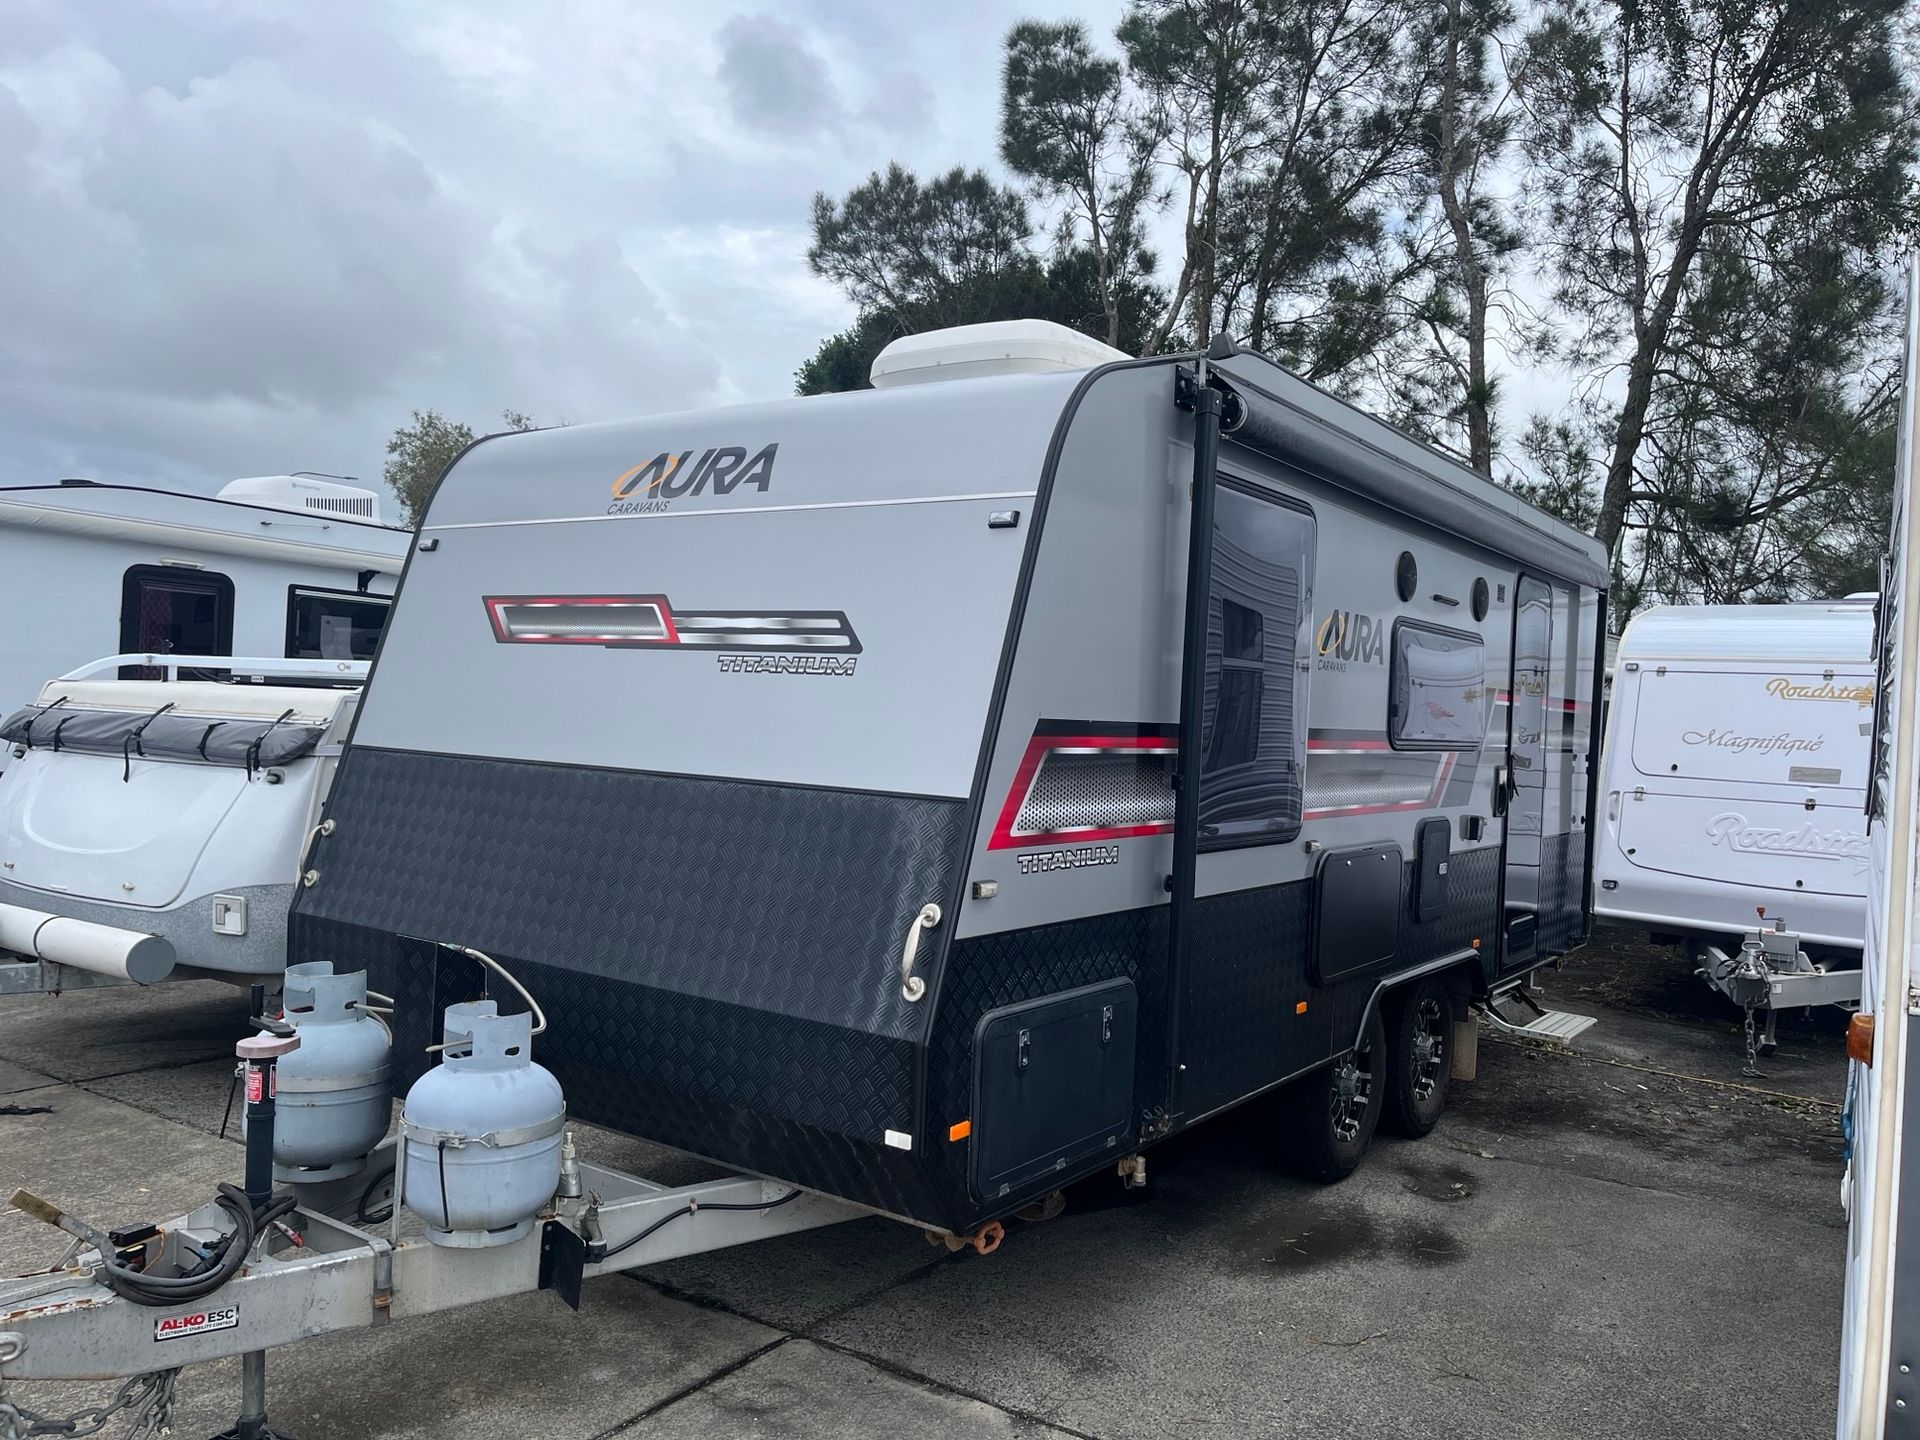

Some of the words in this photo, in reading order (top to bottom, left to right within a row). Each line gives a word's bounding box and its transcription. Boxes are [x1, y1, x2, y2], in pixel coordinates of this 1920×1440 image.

[612, 442, 780, 501] AURA
[607, 500, 671, 515] CARAVANS
[1317, 608, 1384, 666] AURA
[717, 654, 857, 676] TITANIUM
[1317, 659, 1348, 673] CARAVANS
[1765, 677, 1873, 702] Roadsta
[1681, 728, 1824, 757] Magnifiqué
[1705, 811, 1871, 859] Roadsta
[1017, 845, 1119, 875] TITANIUM
[160, 1313, 206, 1332] AL-KO
[207, 1308, 235, 1323] ESC
[212, 1319, 235, 1328] CONTROL
